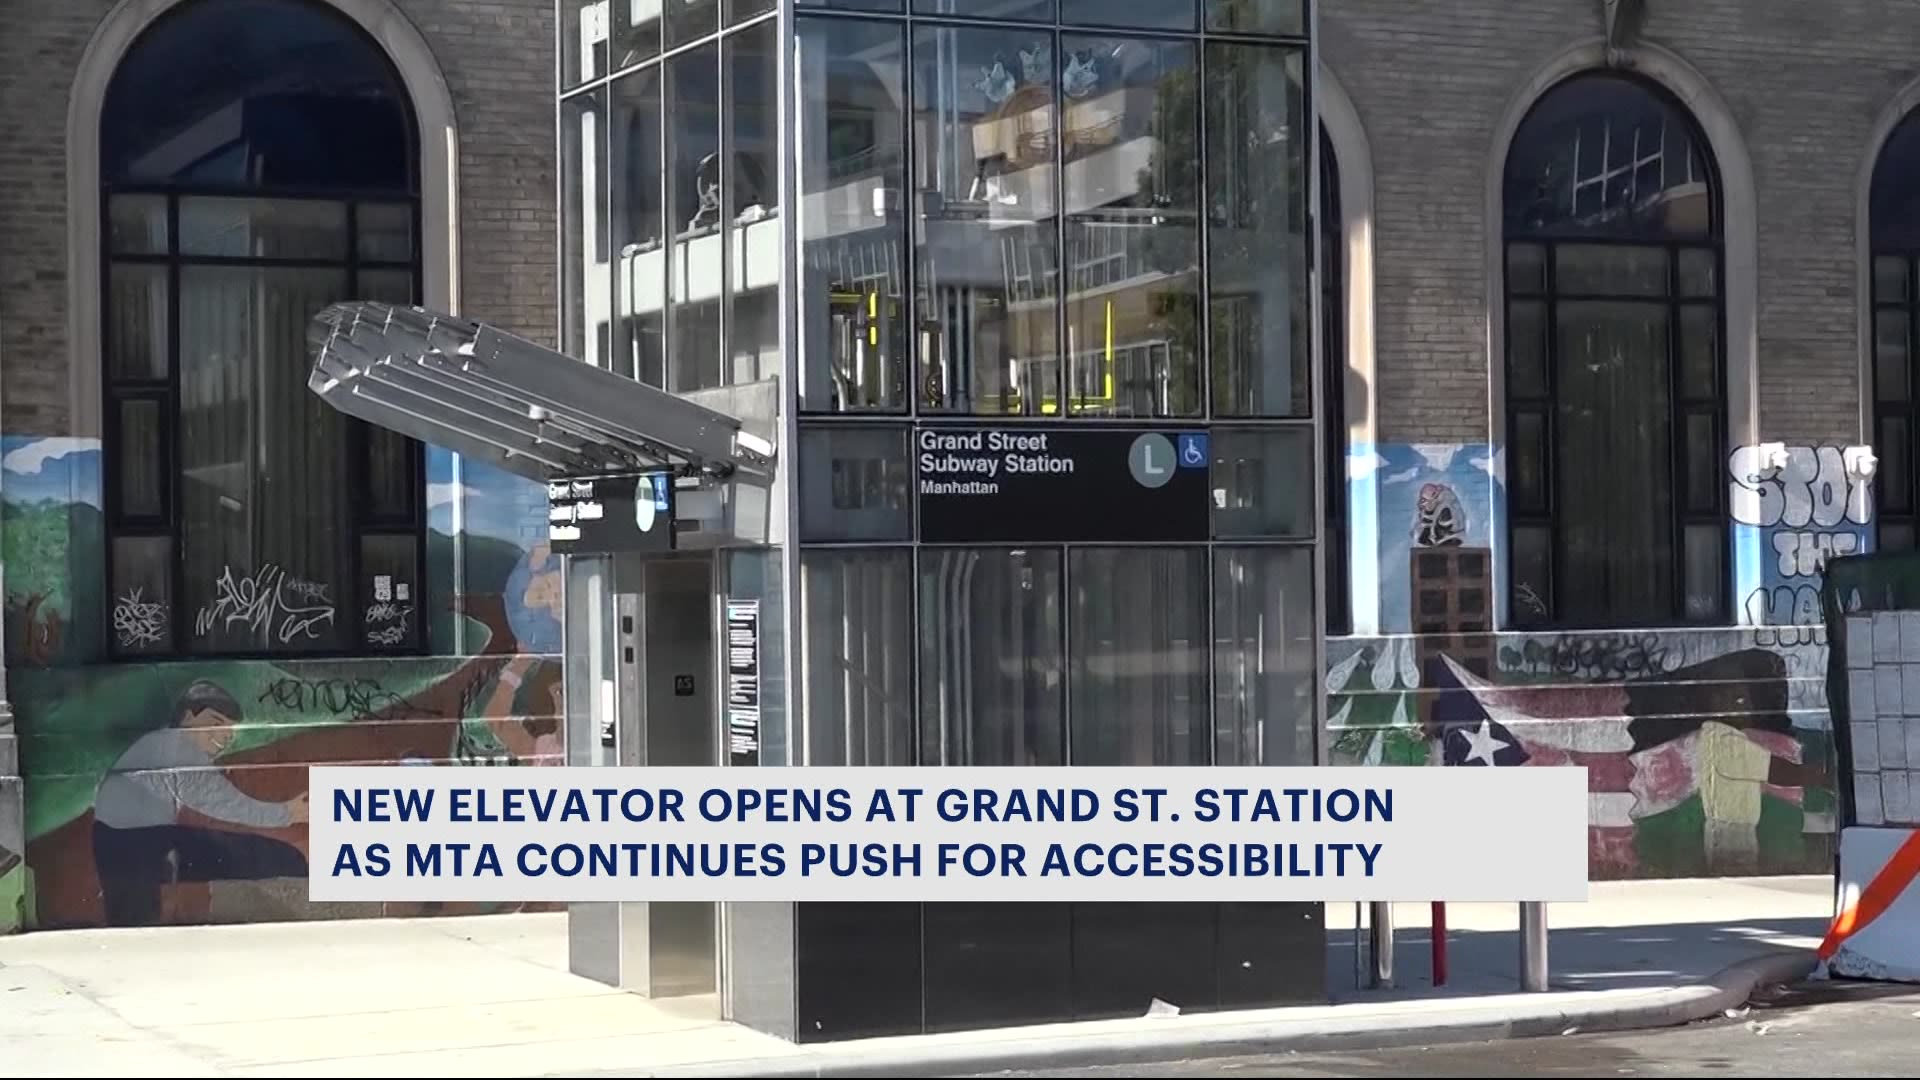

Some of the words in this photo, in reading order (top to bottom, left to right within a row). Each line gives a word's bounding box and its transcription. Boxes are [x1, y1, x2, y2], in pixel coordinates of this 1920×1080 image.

[920, 431, 982, 450] Grand
[988, 431, 1048, 450] Street
[920, 453, 998, 477] Subway
[1005, 453, 1074, 473] Station
[920, 479, 999, 494] Manhattan
